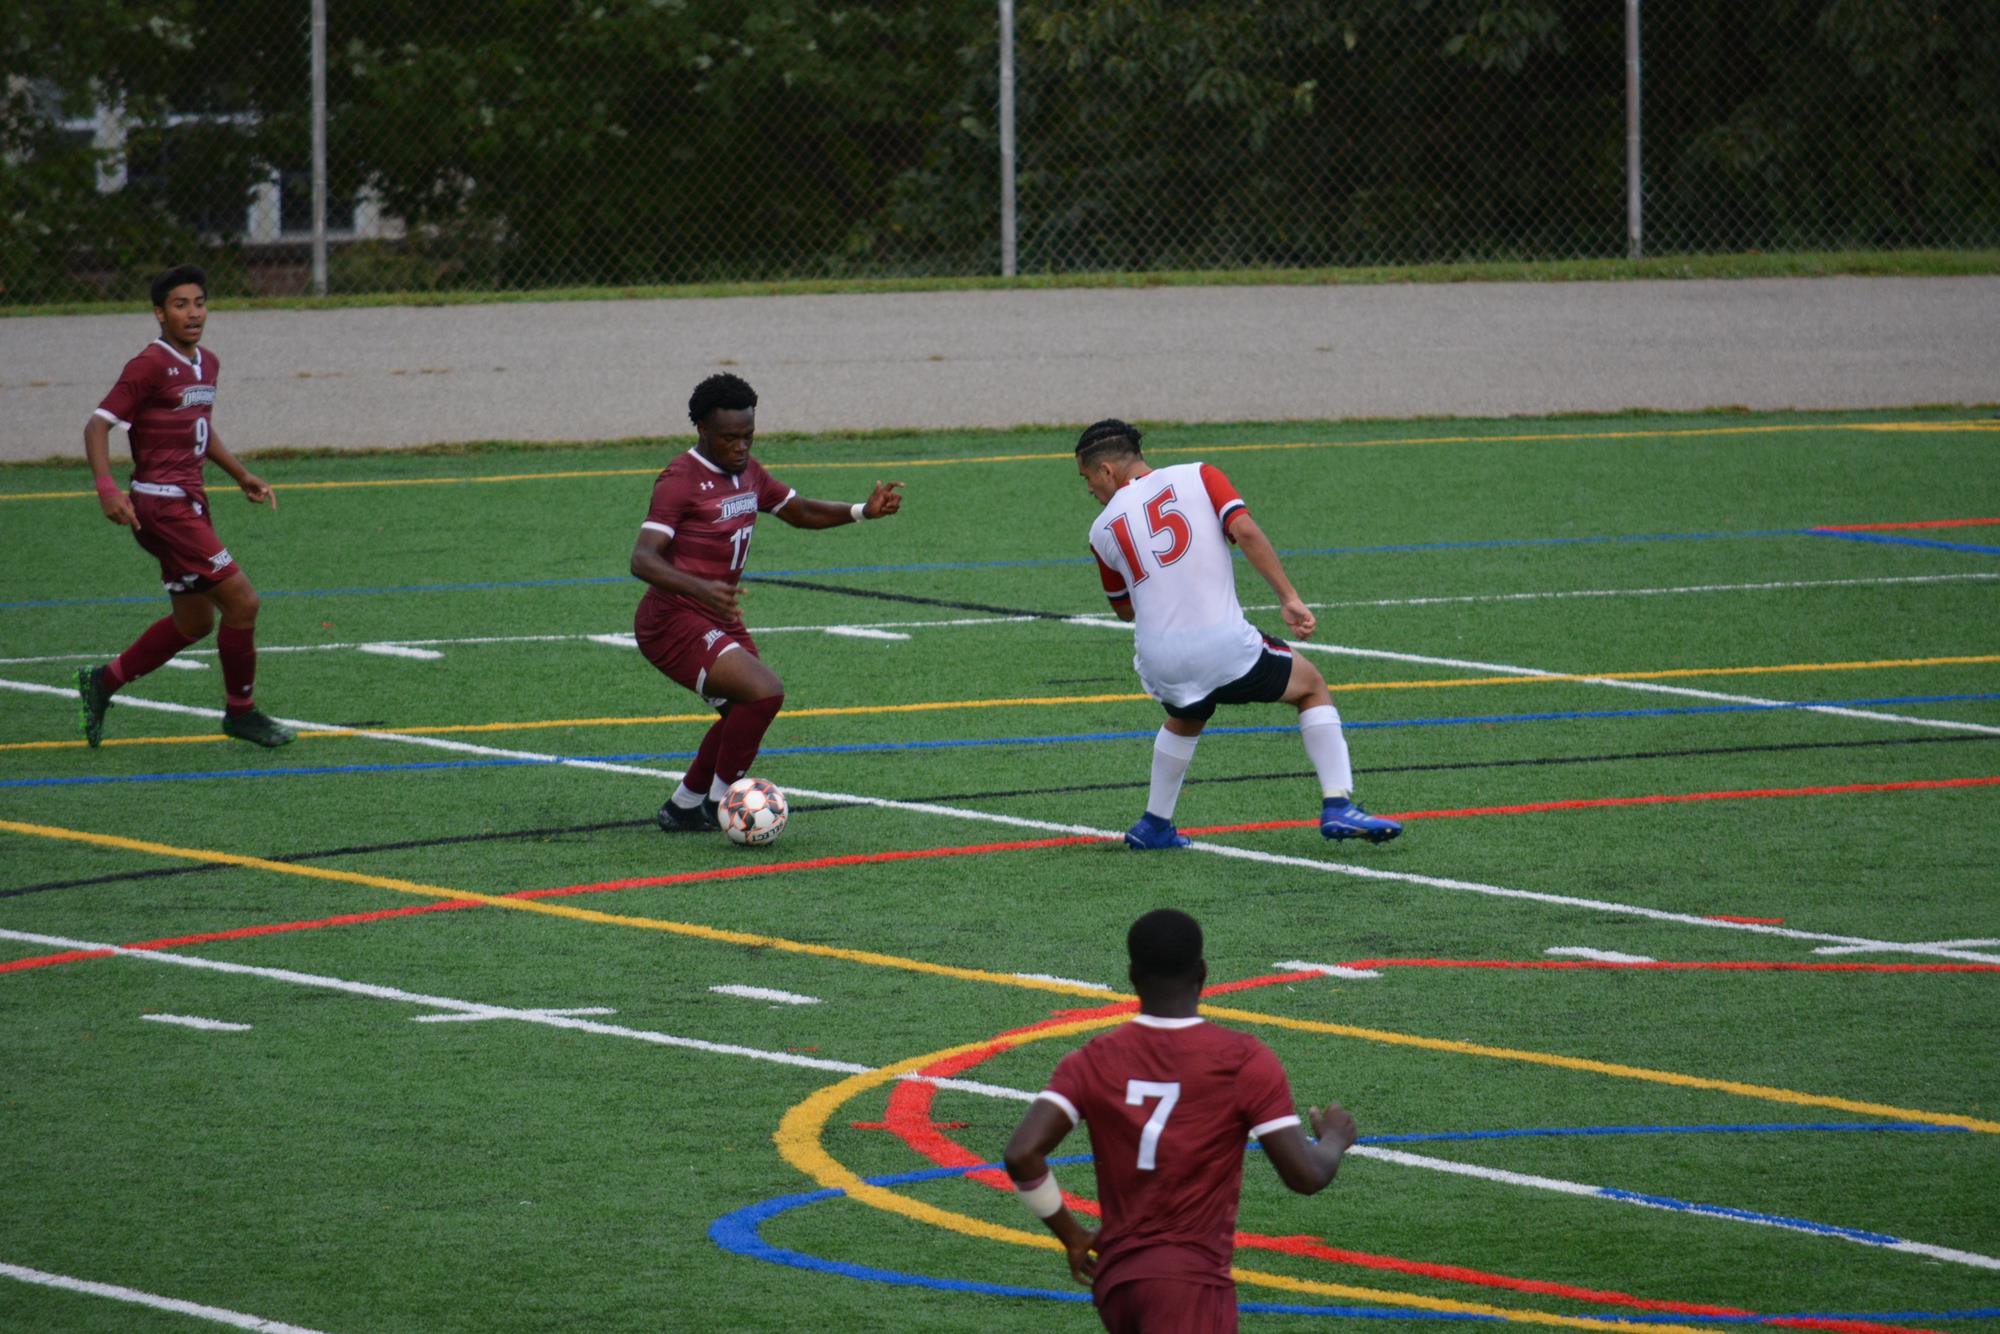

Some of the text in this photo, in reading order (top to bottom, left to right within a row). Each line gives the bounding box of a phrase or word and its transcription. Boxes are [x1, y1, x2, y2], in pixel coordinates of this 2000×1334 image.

[194, 416, 208, 456] 9
[730, 525, 753, 570] 17
[1104, 484, 1192, 587] 15
[1125, 1079, 1181, 1170] 7
